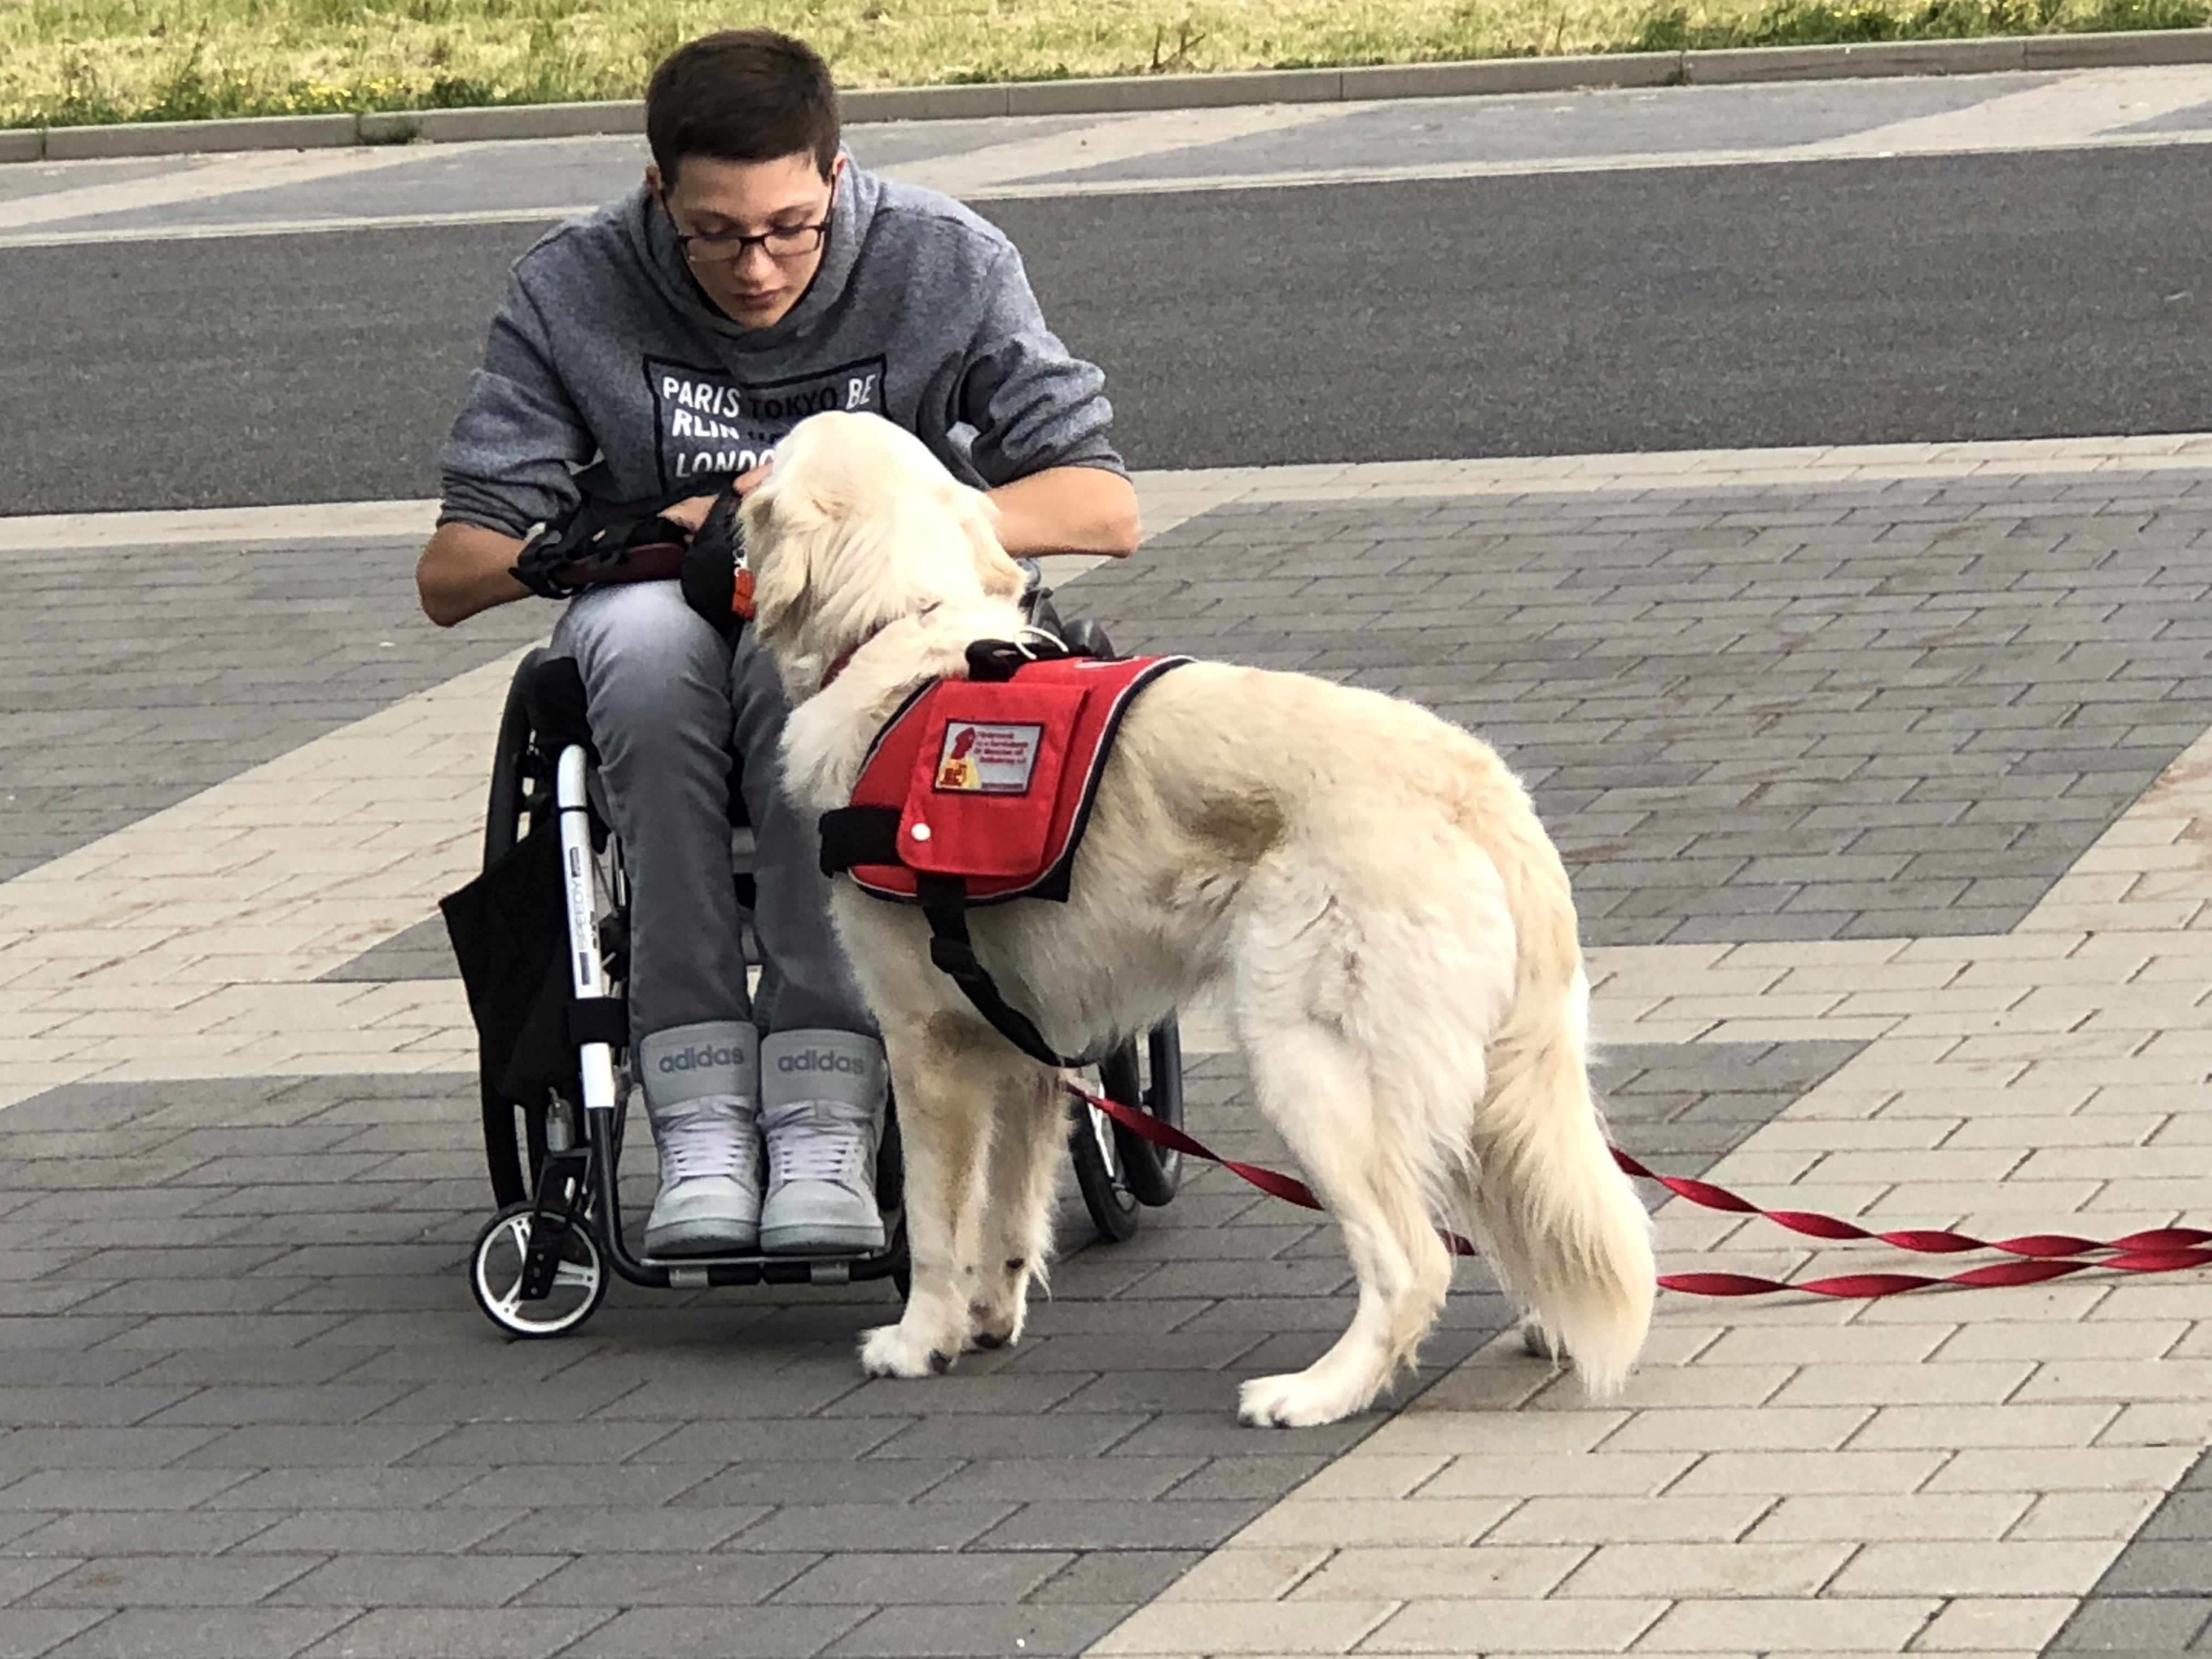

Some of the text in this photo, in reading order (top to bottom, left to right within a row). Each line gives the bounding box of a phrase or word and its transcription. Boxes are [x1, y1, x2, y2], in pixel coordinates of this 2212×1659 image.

[662, 374, 876, 419] PARIS TOKYO BE
[672, 408, 740, 439] RLIN
[659, 1044, 745, 1073] adidas
[777, 1049, 865, 1075] adidas
